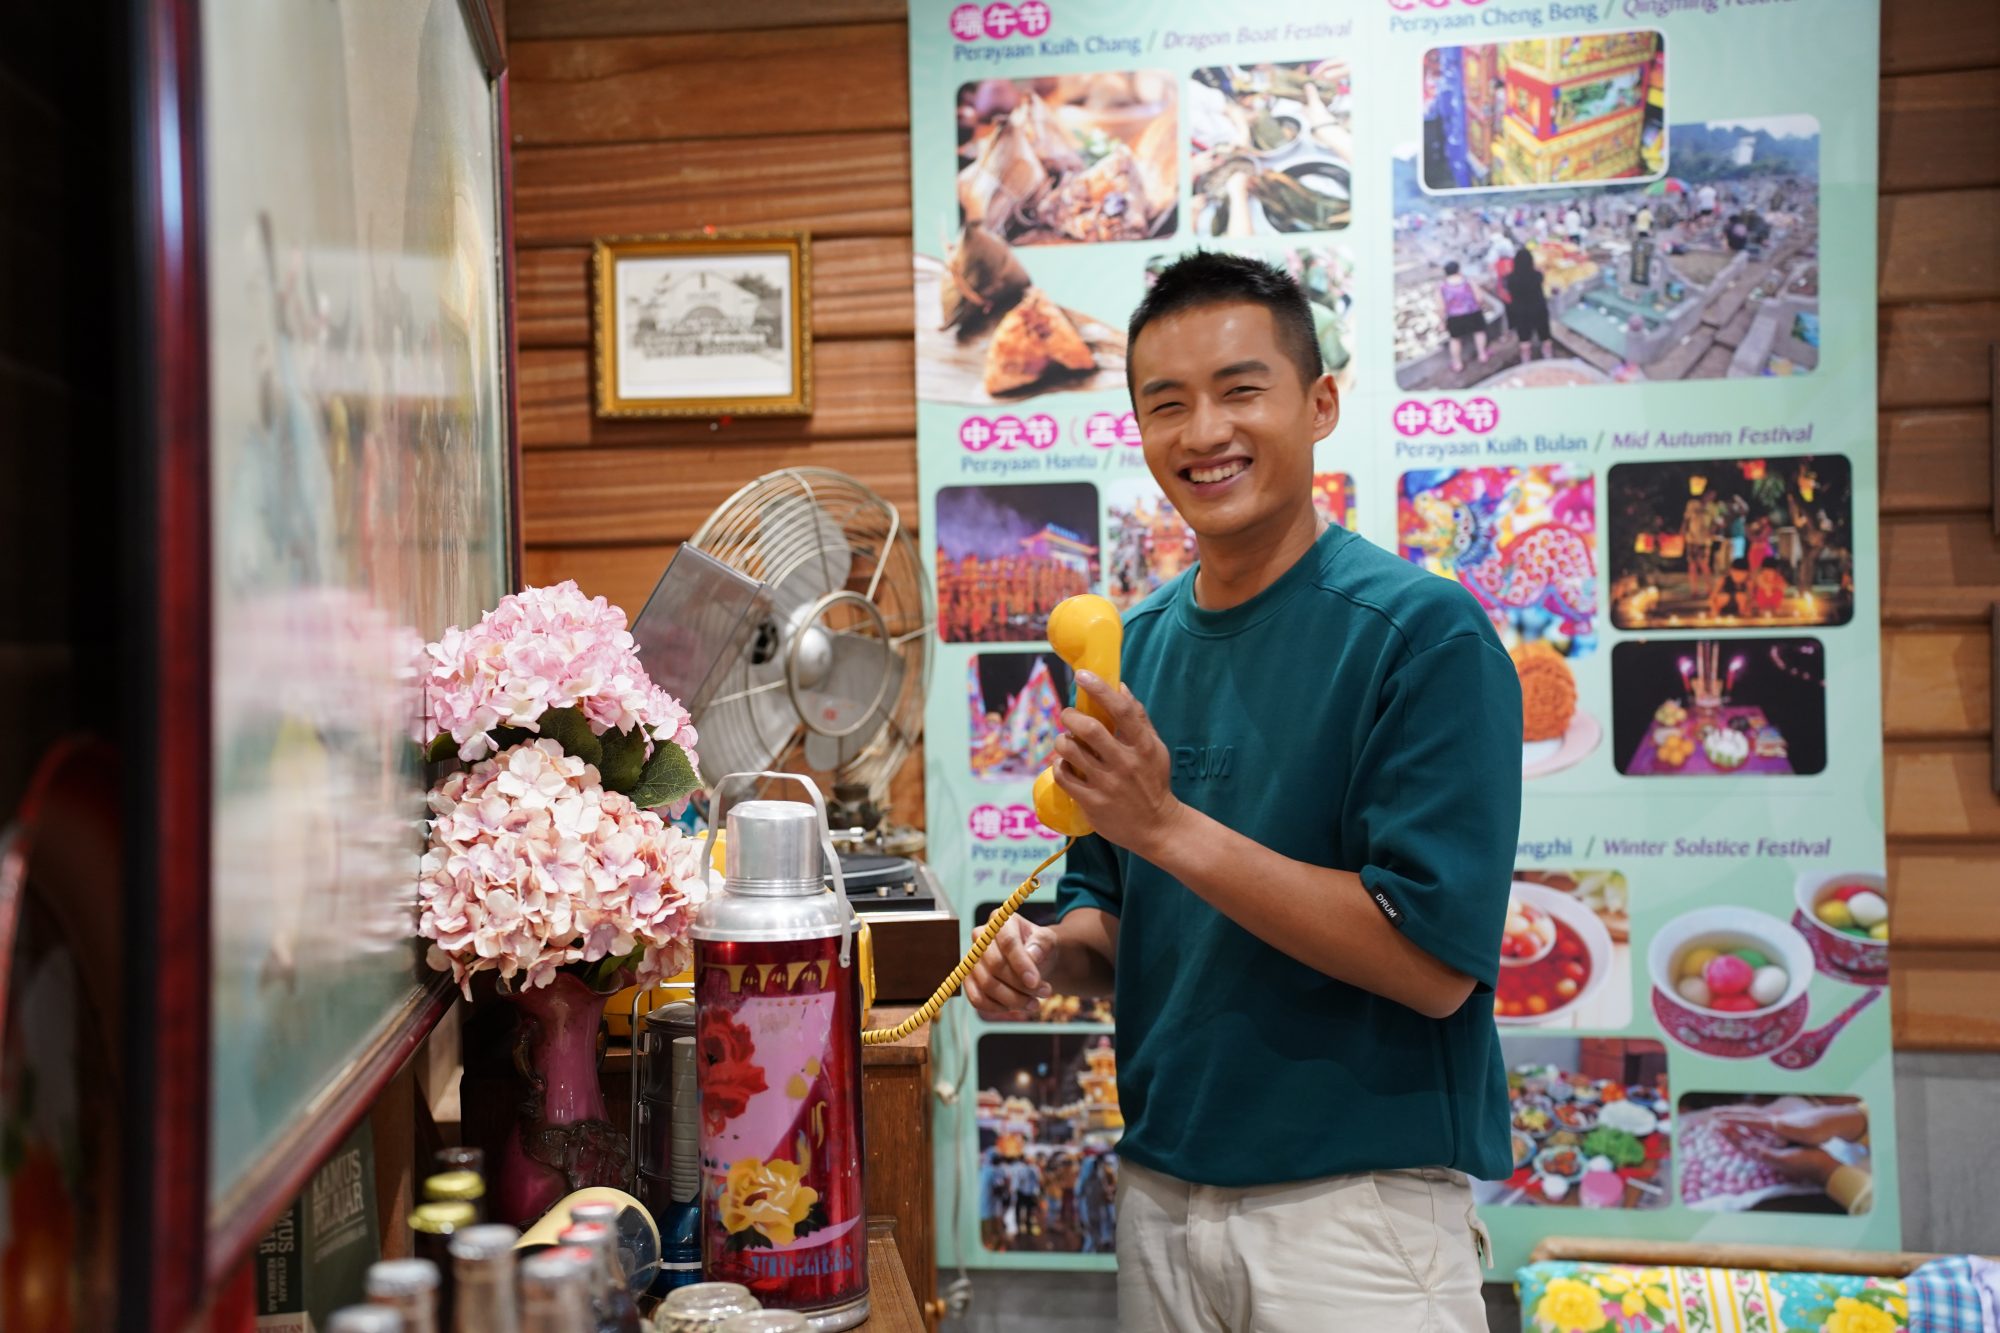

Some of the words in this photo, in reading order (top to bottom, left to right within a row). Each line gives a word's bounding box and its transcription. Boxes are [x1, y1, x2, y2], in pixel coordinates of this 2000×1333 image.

[1389, 13, 1475, 34] Perayaan
[1482, 8, 1542, 28] Cheng
[1549, 3, 1598, 23] Beng
[954, 43, 1034, 64] Perayaan
[1040, 36, 1079, 57] Kuih
[1085, 34, 1142, 57] Chang
[1163, 30, 1231, 52] Dragon
[1237, 25, 1278, 45] Boat
[1284, 18, 1353, 40] Festival
[961, 414, 1058, 451] 中元节
[1395, 399, 1496, 435] 中秋节
[1396, 440, 1479, 462] Perayaan
[1487, 436, 1527, 454] Kuih
[1535, 432, 1588, 453] Bulan
[1612, 430, 1649, 449] Mid
[1655, 429, 1732, 449] Autumn
[1739, 423, 1813, 445] Festival
[960, 455, 1040, 477] Perayaan
[1046, 453, 1097, 471] Hantu
[1171, 744, 1235, 781] RUM
[971, 844, 1051, 866] Perayaan
[1603, 838, 1666, 858] Winter
[1673, 836, 1751, 858] Solstice
[1757, 836, 1831, 858] Festival
[1375, 893, 1397, 918] DRUM
